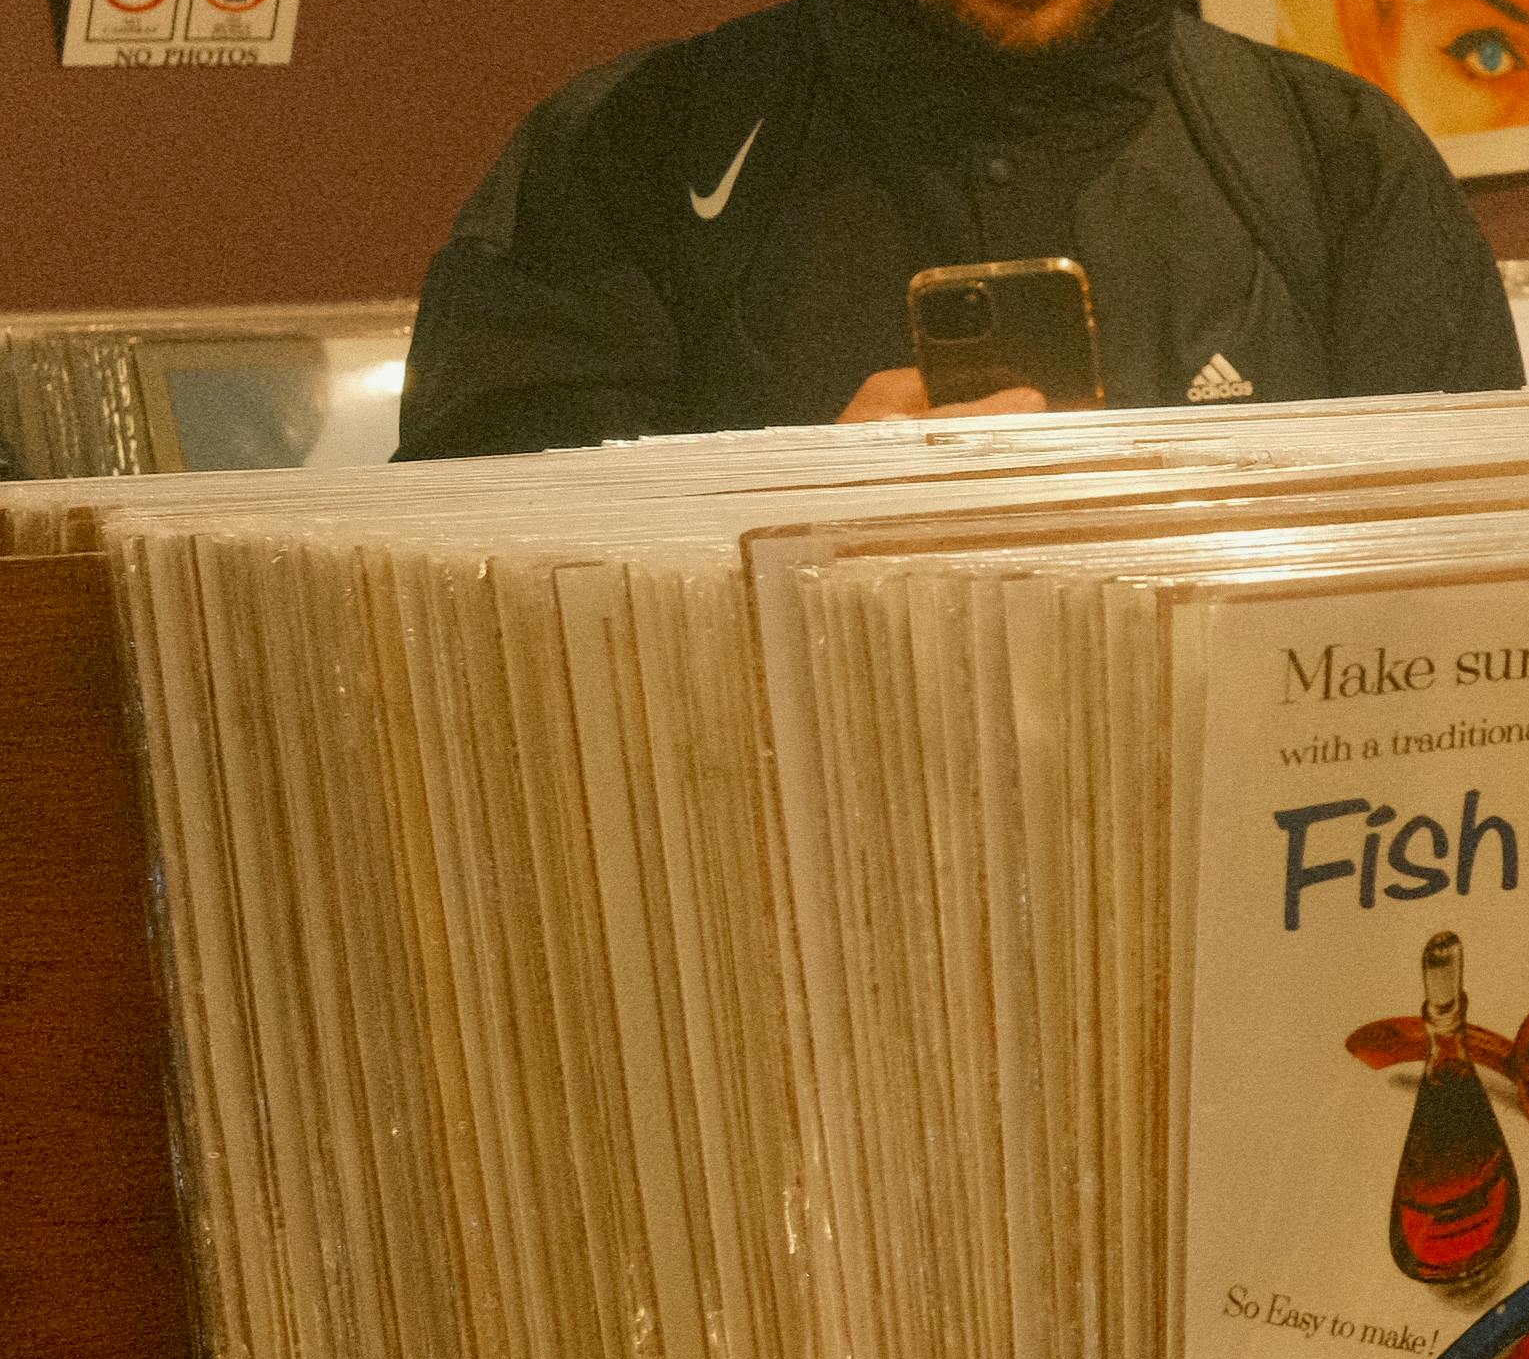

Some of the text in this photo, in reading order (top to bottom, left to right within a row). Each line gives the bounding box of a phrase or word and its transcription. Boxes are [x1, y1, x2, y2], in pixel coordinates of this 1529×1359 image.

[114, 46, 260, 66] NO PHOTOS
[1186, 378, 1254, 402] adidas
[1276, 643, 1438, 708] Make
[1278, 732, 1352, 770] with
[1361, 734, 1381, 760] a
[1273, 787, 1520, 933] Fish
[1222, 1284, 1440, 1359] So Easy to make!
